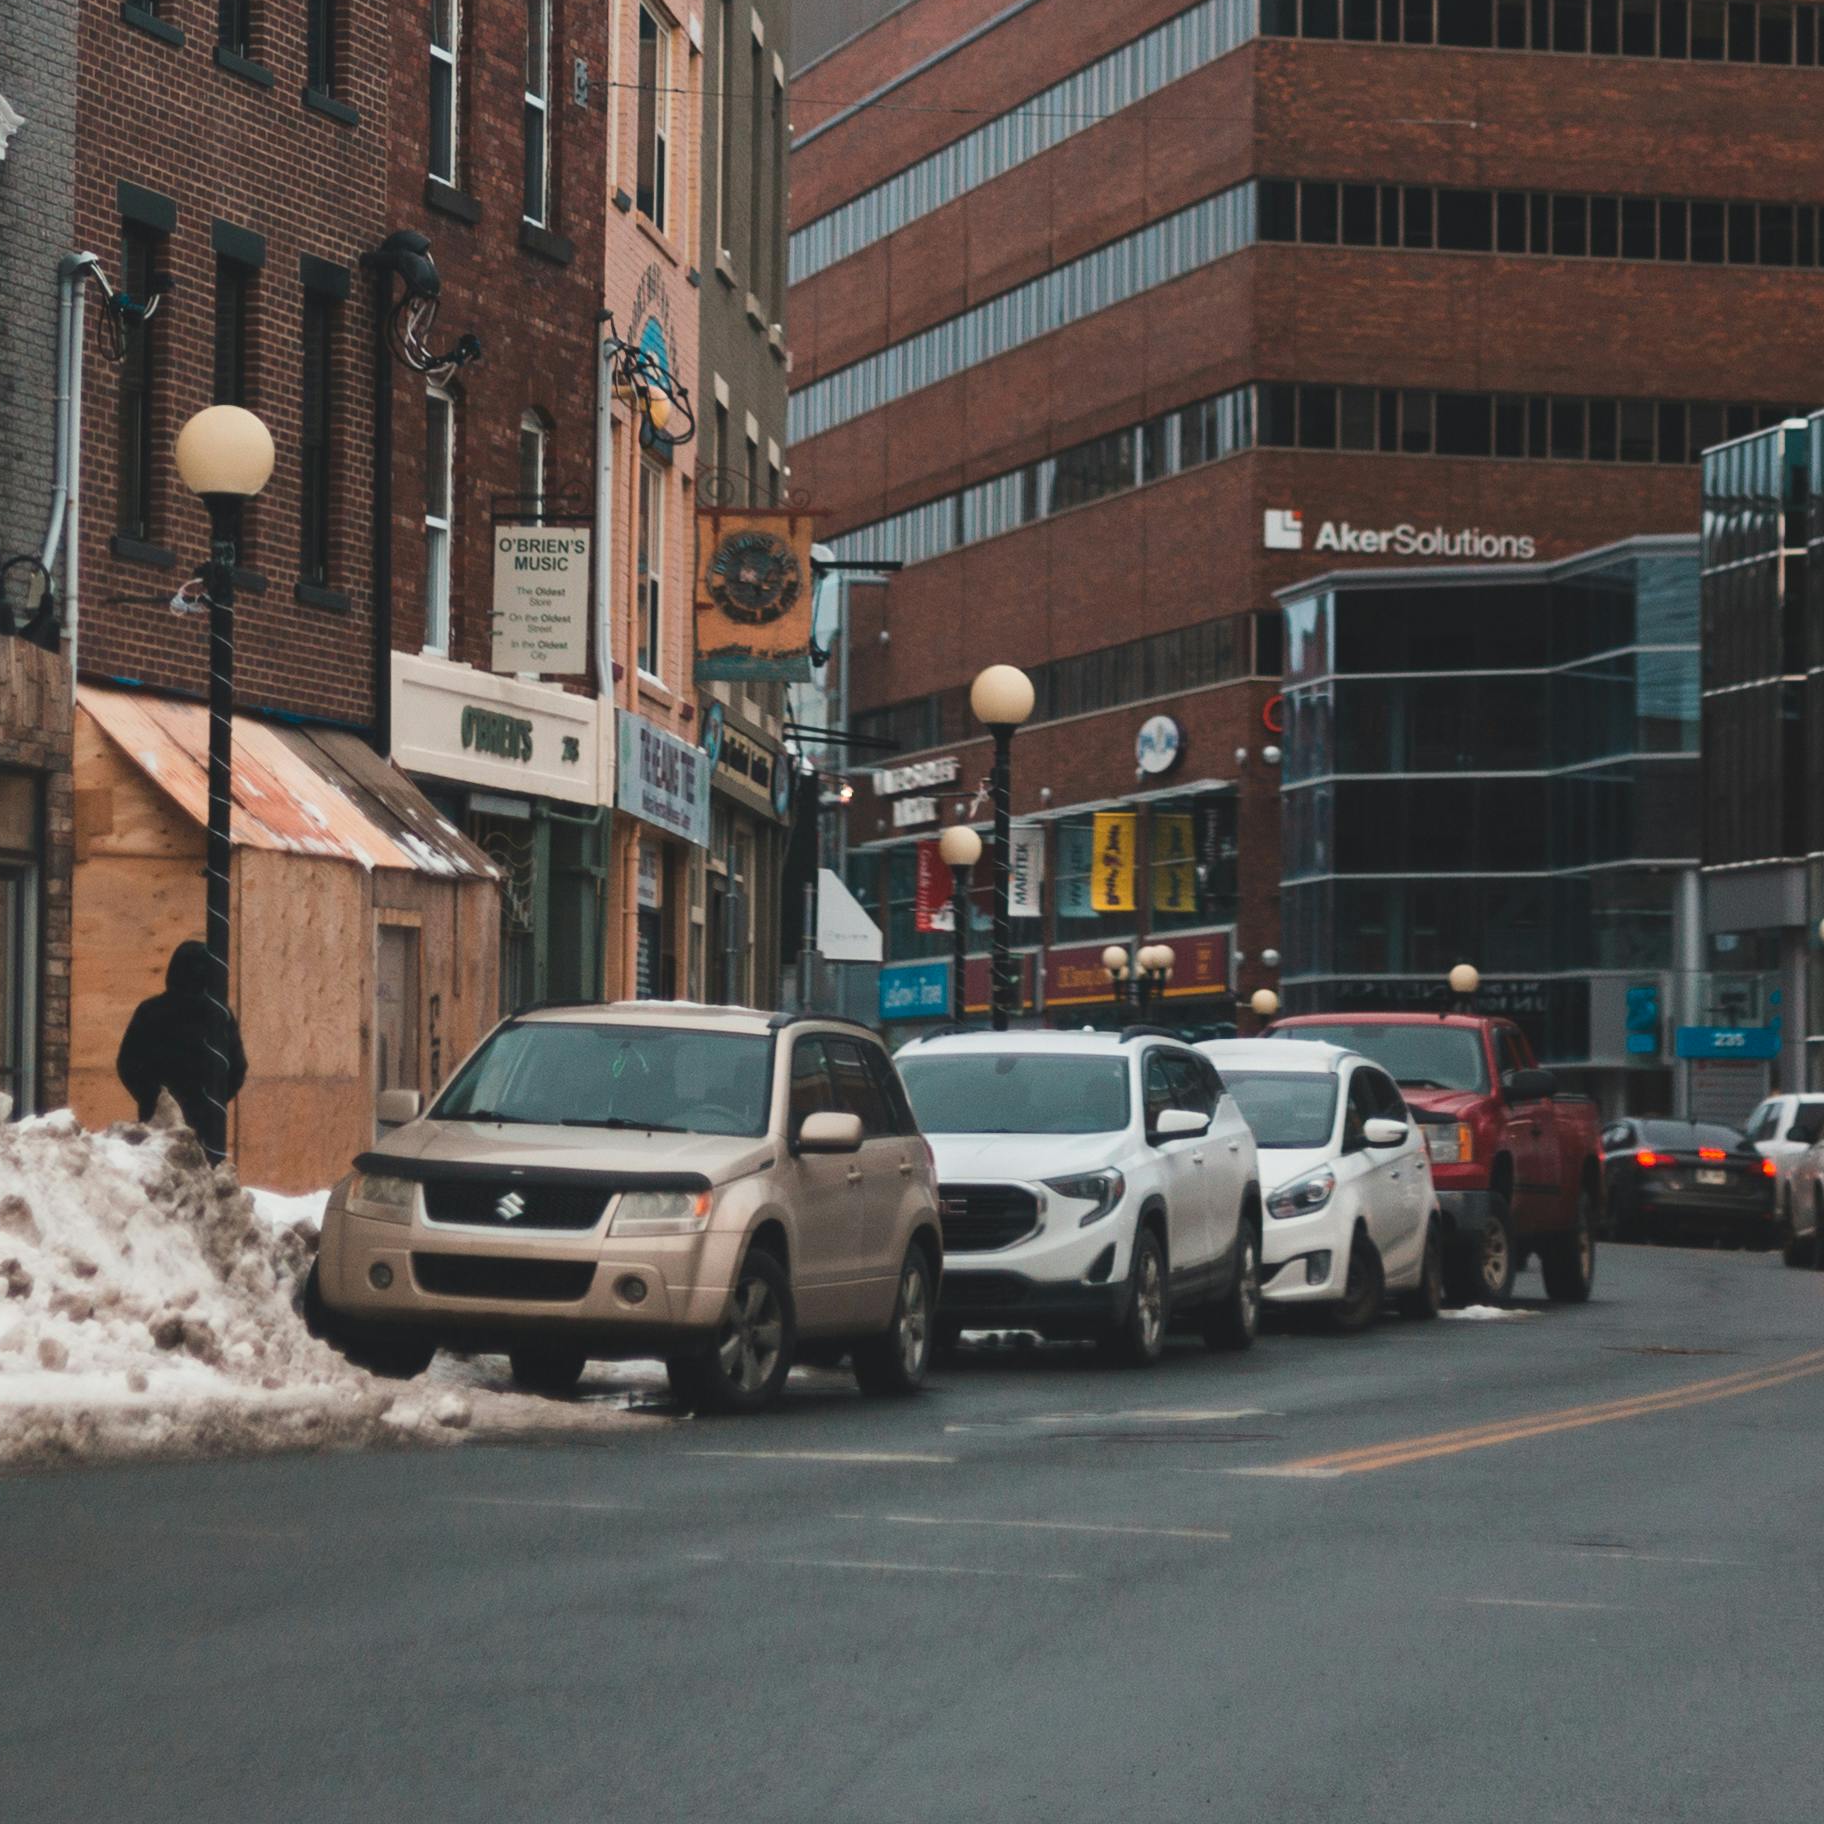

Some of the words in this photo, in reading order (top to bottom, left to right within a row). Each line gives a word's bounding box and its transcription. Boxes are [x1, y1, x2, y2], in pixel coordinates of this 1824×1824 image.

[499, 537, 585, 554] O'BRIEN'S
[1314, 521, 1536, 558] AkerSolutions
[514, 556, 569, 571] MUSIC
[535, 586, 566, 597] Oldest
[541, 613, 572, 623] Oldest
[537, 639, 569, 649] Oldest
[1015, 842, 1028, 906] MARTEK
